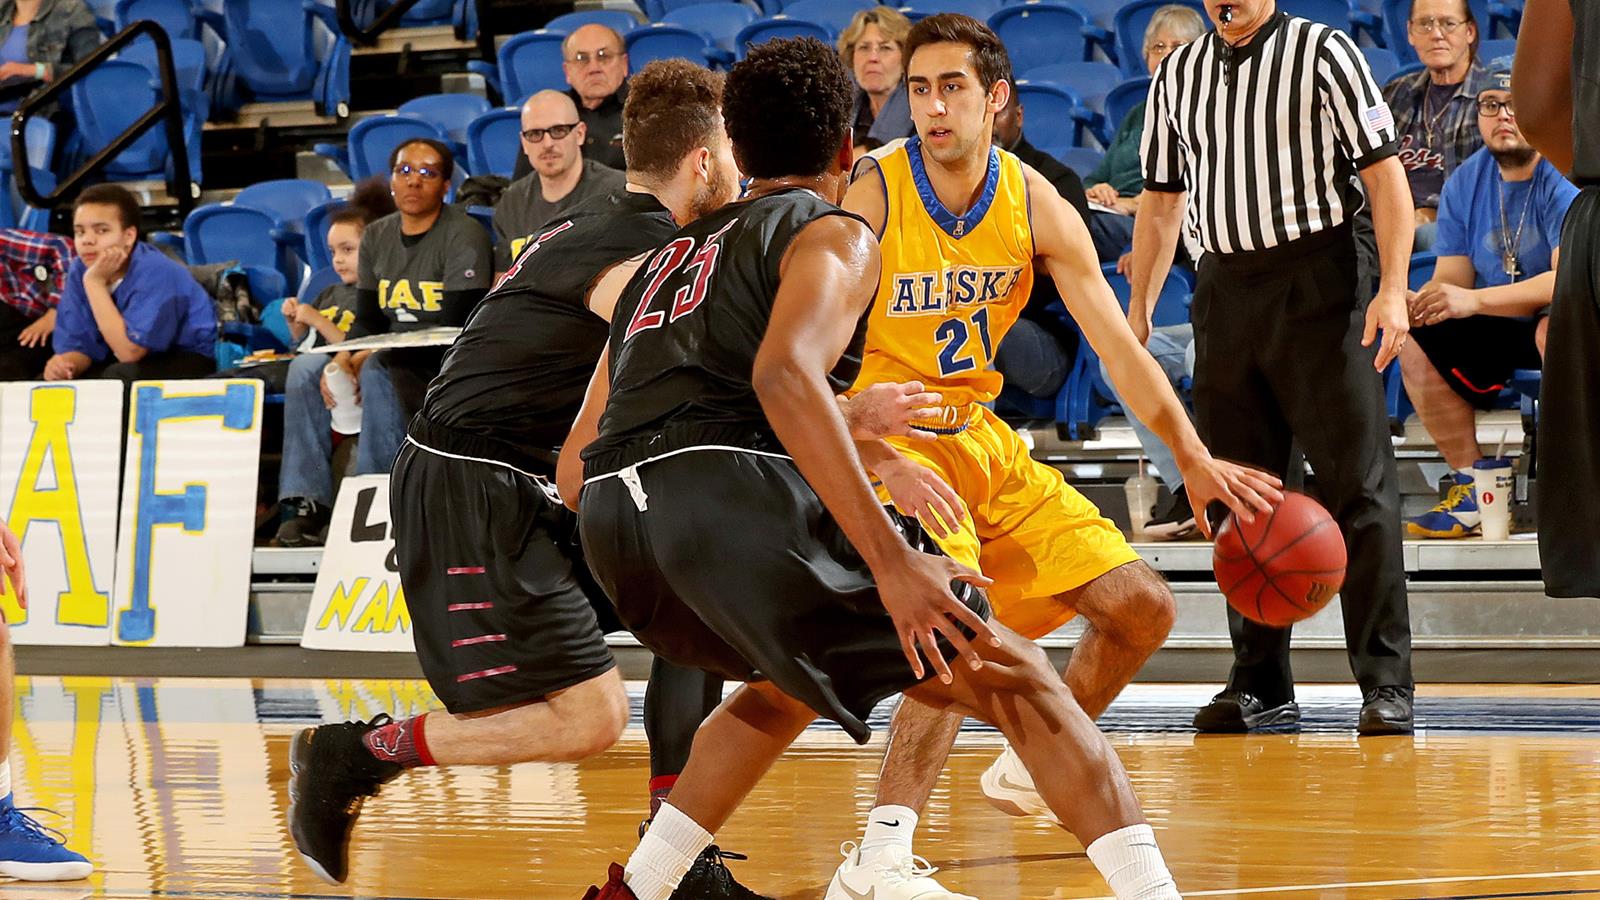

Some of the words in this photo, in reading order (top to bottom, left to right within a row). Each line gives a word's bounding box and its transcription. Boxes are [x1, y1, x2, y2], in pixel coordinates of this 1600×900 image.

[622, 217, 738, 343] 25
[887, 265, 1026, 317] ALASKA
[934, 305, 992, 378] 21
